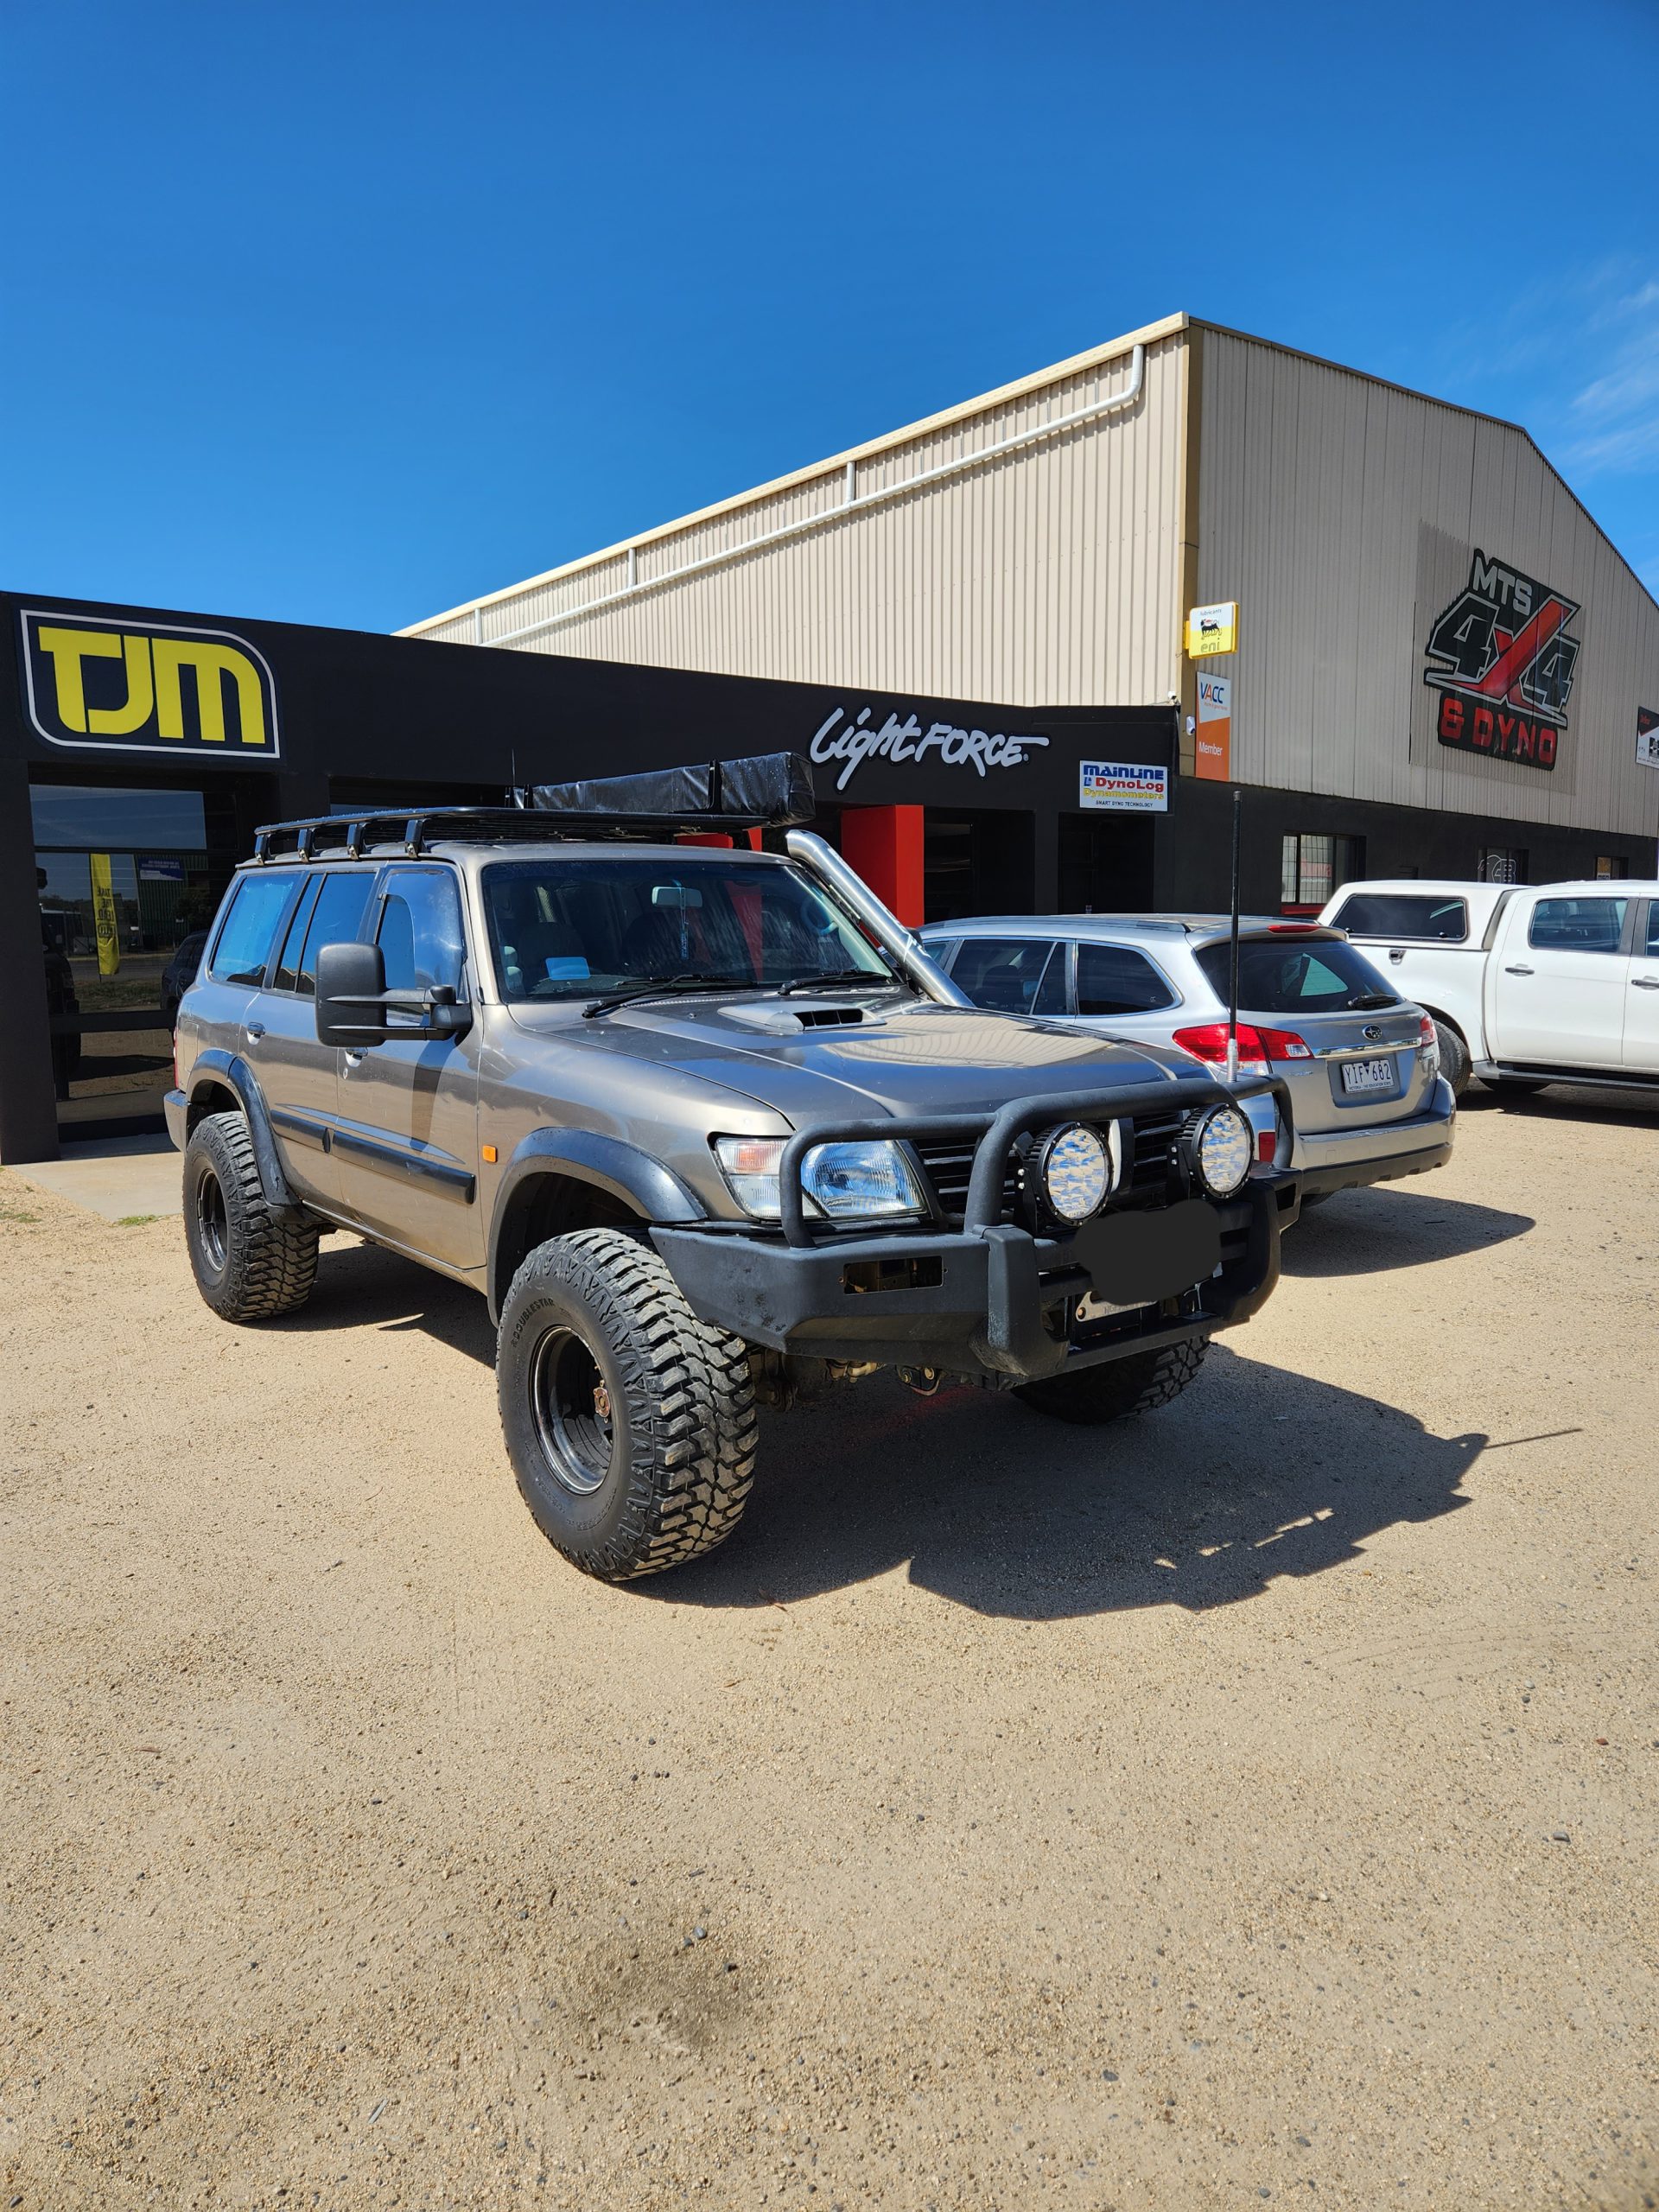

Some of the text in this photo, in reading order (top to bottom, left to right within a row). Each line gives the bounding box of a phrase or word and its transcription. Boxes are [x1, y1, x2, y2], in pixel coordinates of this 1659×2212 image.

[1473, 556, 1532, 616] MTS
[1200, 637, 1220, 653] eni
[38, 626, 265, 744] TJM
[1200, 681, 1224, 704] VACC
[1441, 697, 1557, 764] & DYNO
[1198, 741, 1223, 756] Member
[1083, 787, 1164, 800] Dynamometers
[1096, 777, 1164, 792] DynoLog
[1345, 1064, 1391, 1084] YIF 682
[512, 1298, 556, 1340] DOUBLESTAR
